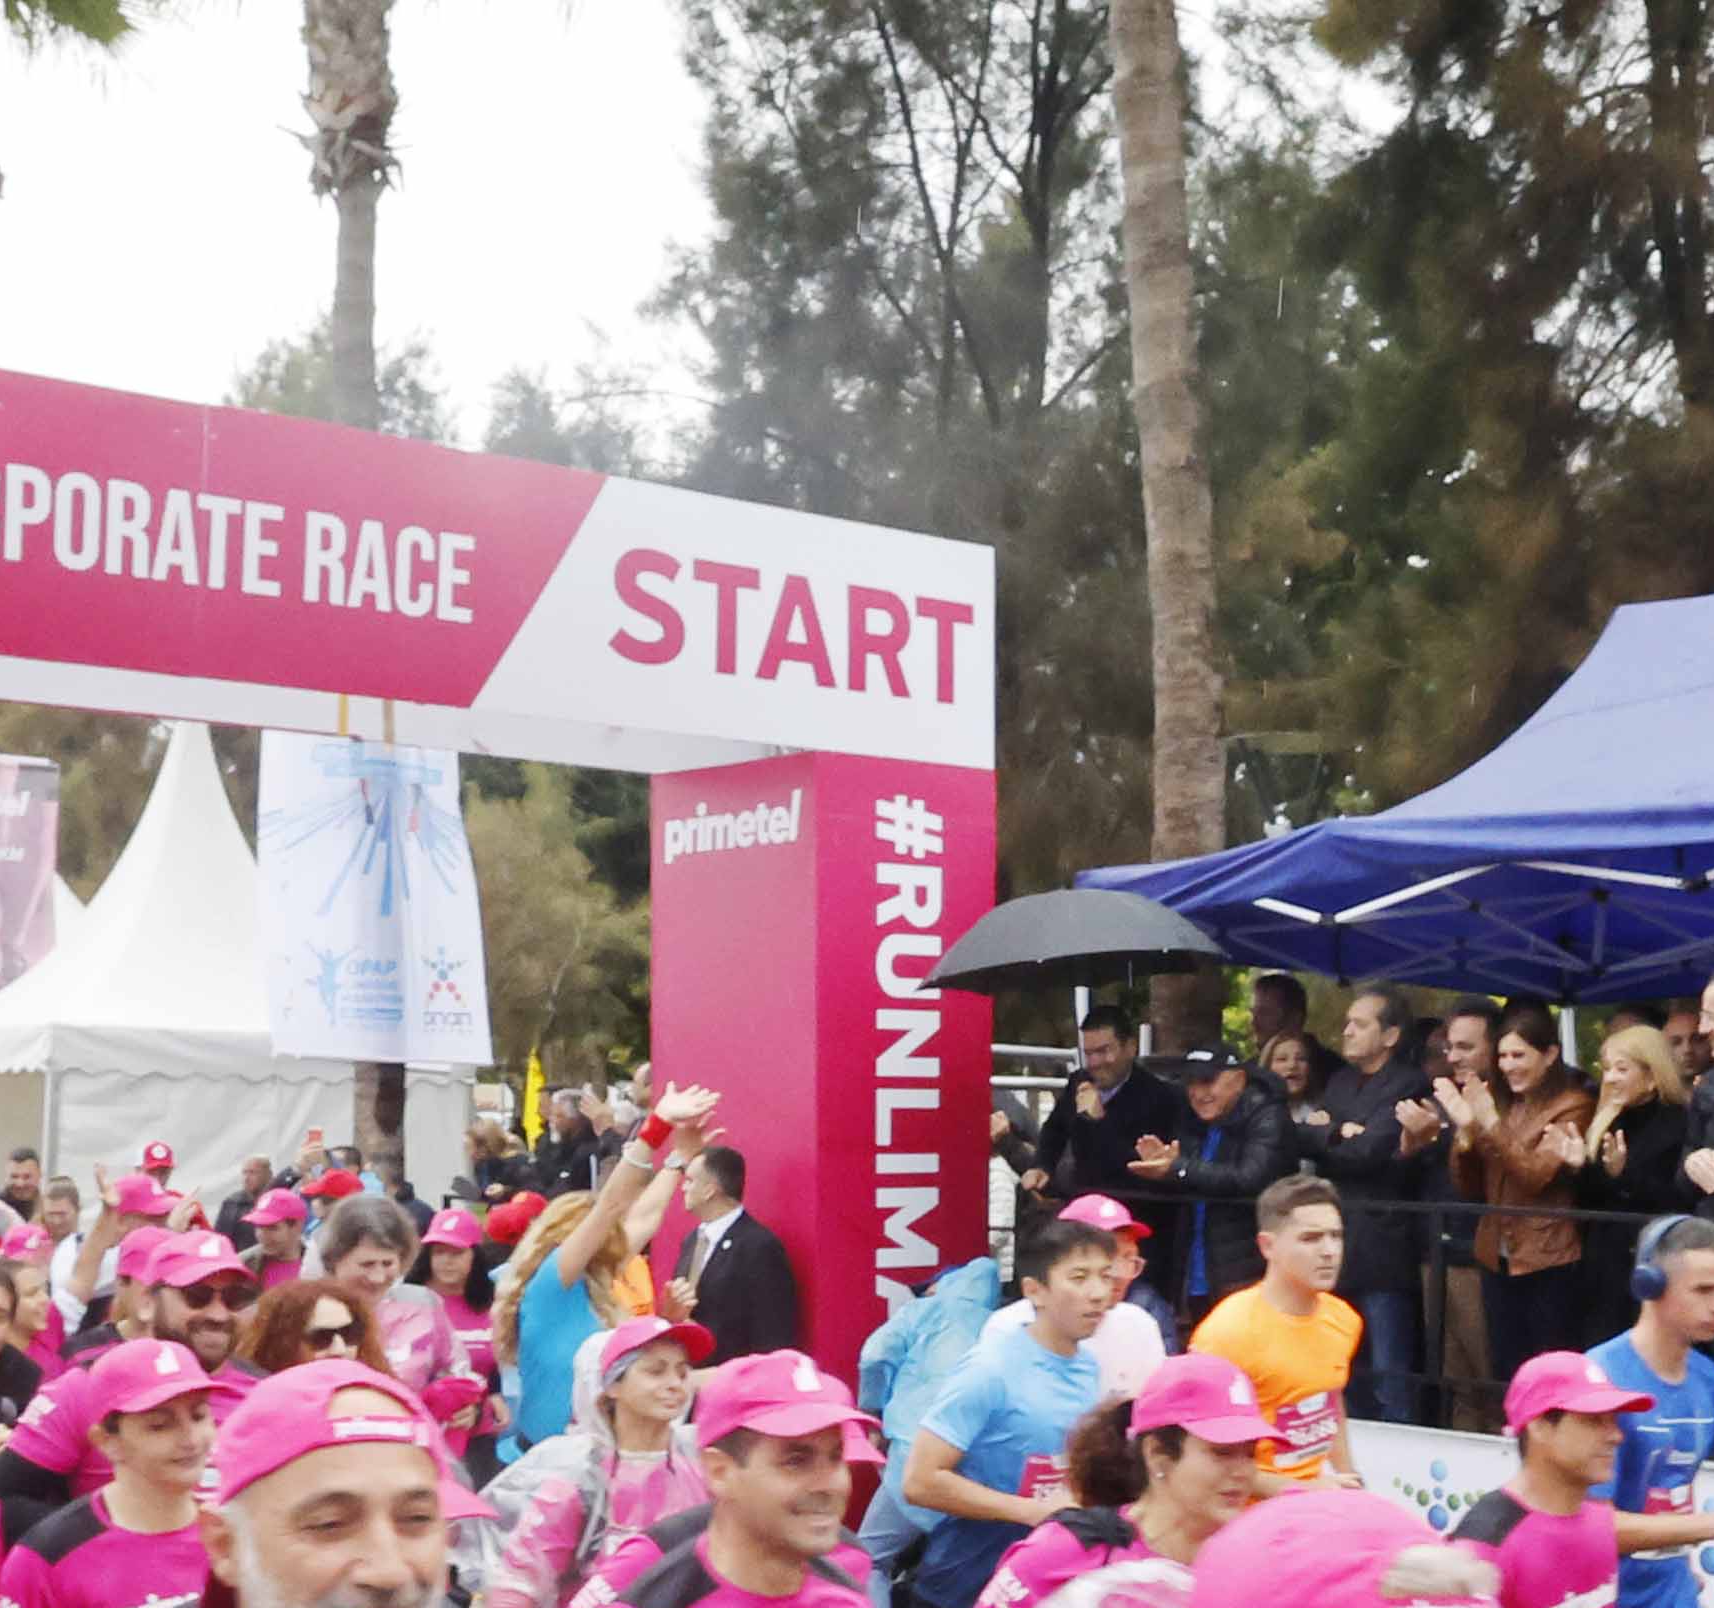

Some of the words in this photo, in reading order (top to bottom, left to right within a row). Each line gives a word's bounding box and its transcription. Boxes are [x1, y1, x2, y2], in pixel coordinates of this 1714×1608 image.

[302, 510, 476, 624] RACE
[609, 548, 974, 704] START
[664, 789, 802, 864] primetel
